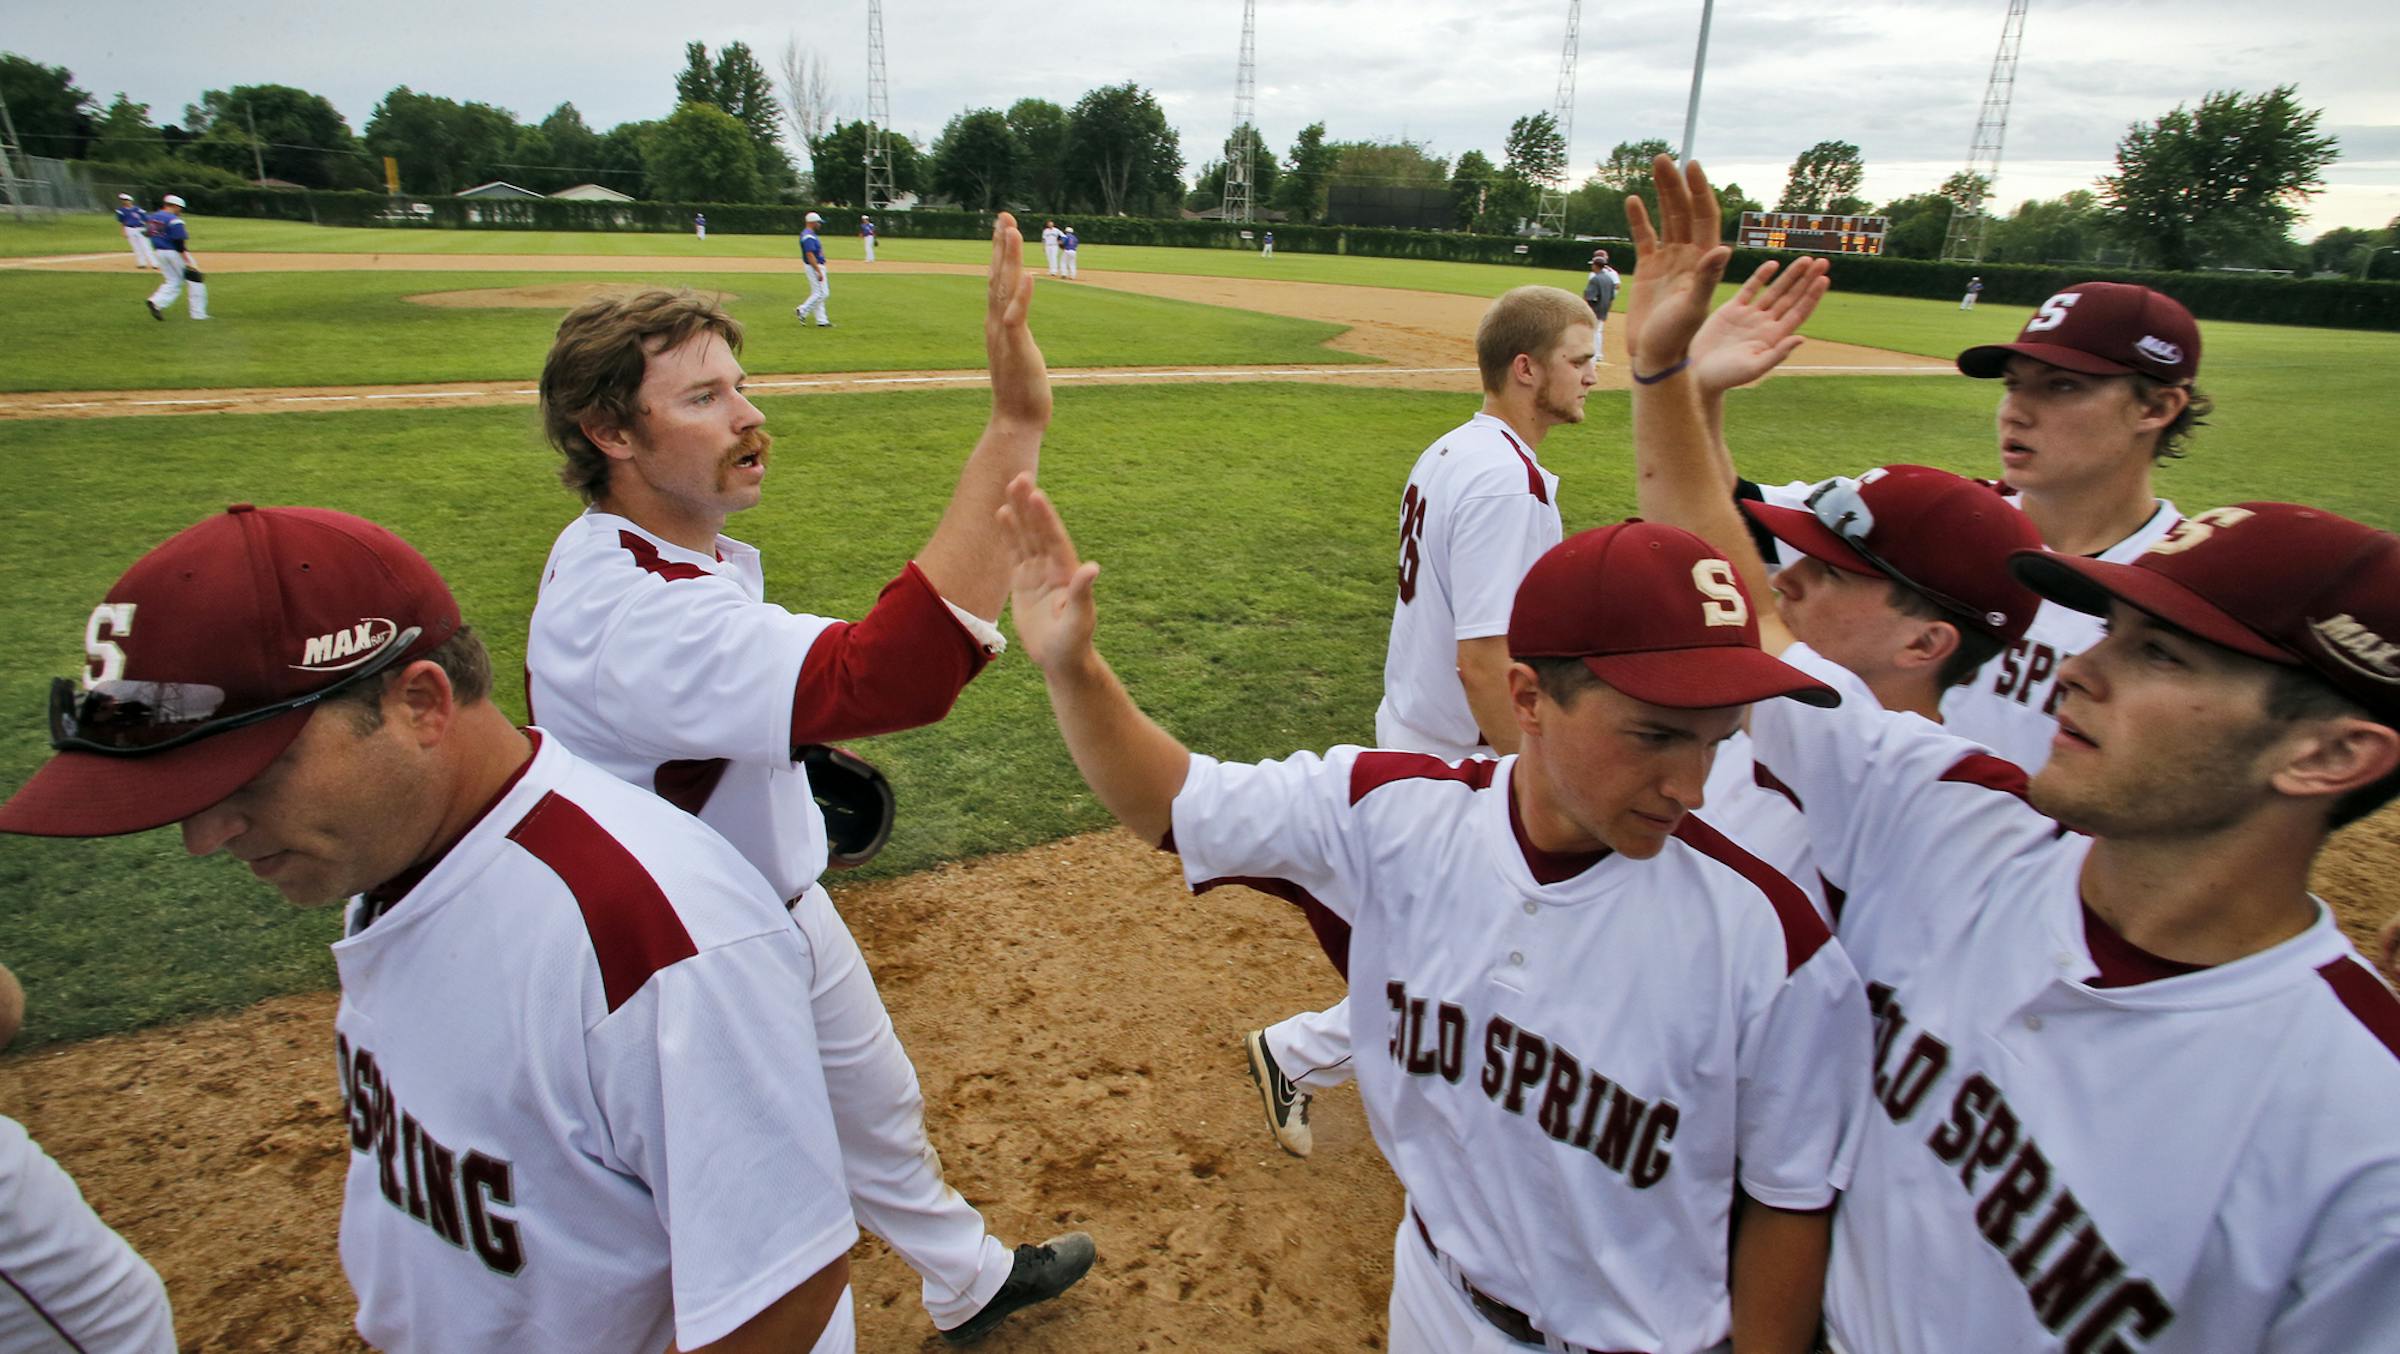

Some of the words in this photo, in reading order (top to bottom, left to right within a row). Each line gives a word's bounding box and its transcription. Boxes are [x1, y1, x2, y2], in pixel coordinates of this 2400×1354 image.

[2024, 292, 2082, 333] S
[2149, 506, 2257, 555] S
[1691, 558, 1749, 627] S
[83, 603, 137, 692] S
[302, 621, 372, 665] MAX
[1480, 1013, 1680, 1189] SPRING
[351, 1046, 527, 1278] SPRING
[1926, 1071, 2175, 1354] SPRING
